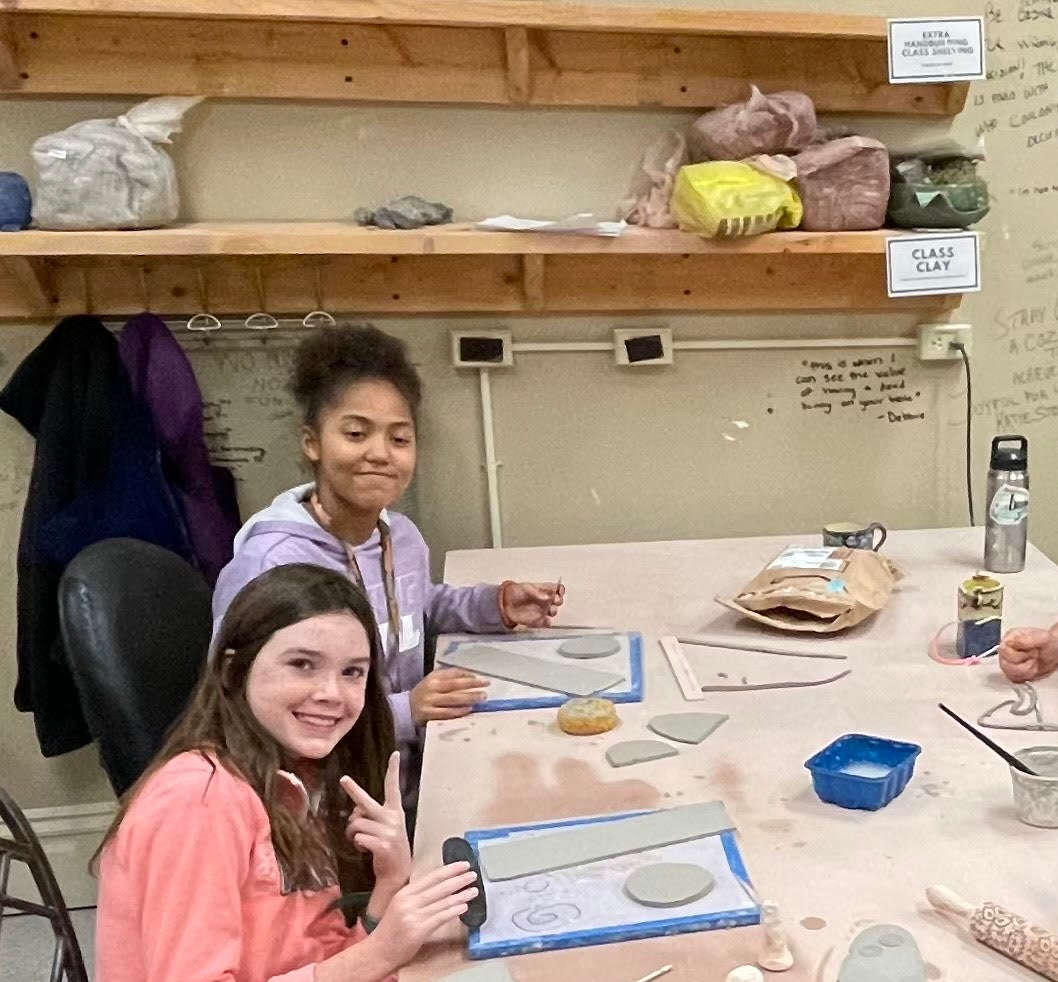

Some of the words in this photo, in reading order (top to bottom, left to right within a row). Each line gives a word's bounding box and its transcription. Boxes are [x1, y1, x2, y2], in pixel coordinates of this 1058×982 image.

[922, 30, 951, 39] EXTRA
[901, 47, 930, 57] CLASS
[912, 246, 954, 260] CLASS
[916, 260, 951, 273] CLAY
[824, 373, 844, 383] see
